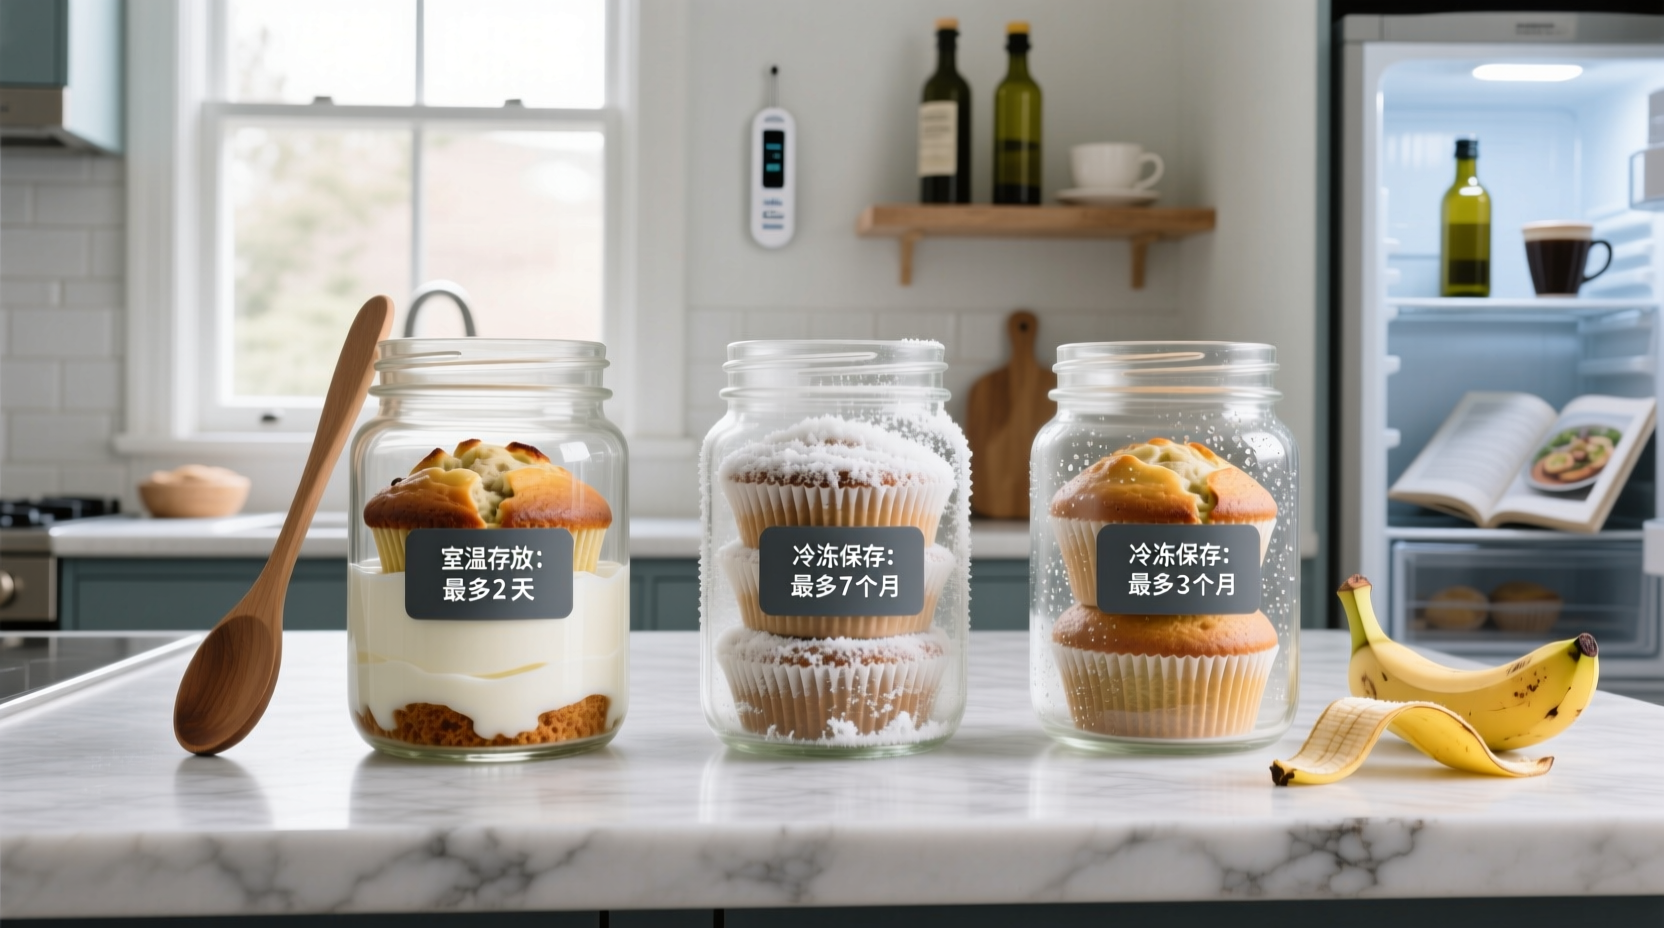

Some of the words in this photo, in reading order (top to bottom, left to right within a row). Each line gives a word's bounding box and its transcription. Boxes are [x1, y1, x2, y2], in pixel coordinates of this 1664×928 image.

[791, 574, 898, 598] 最多7个月
[1129, 572, 1235, 596] 最多3个月
